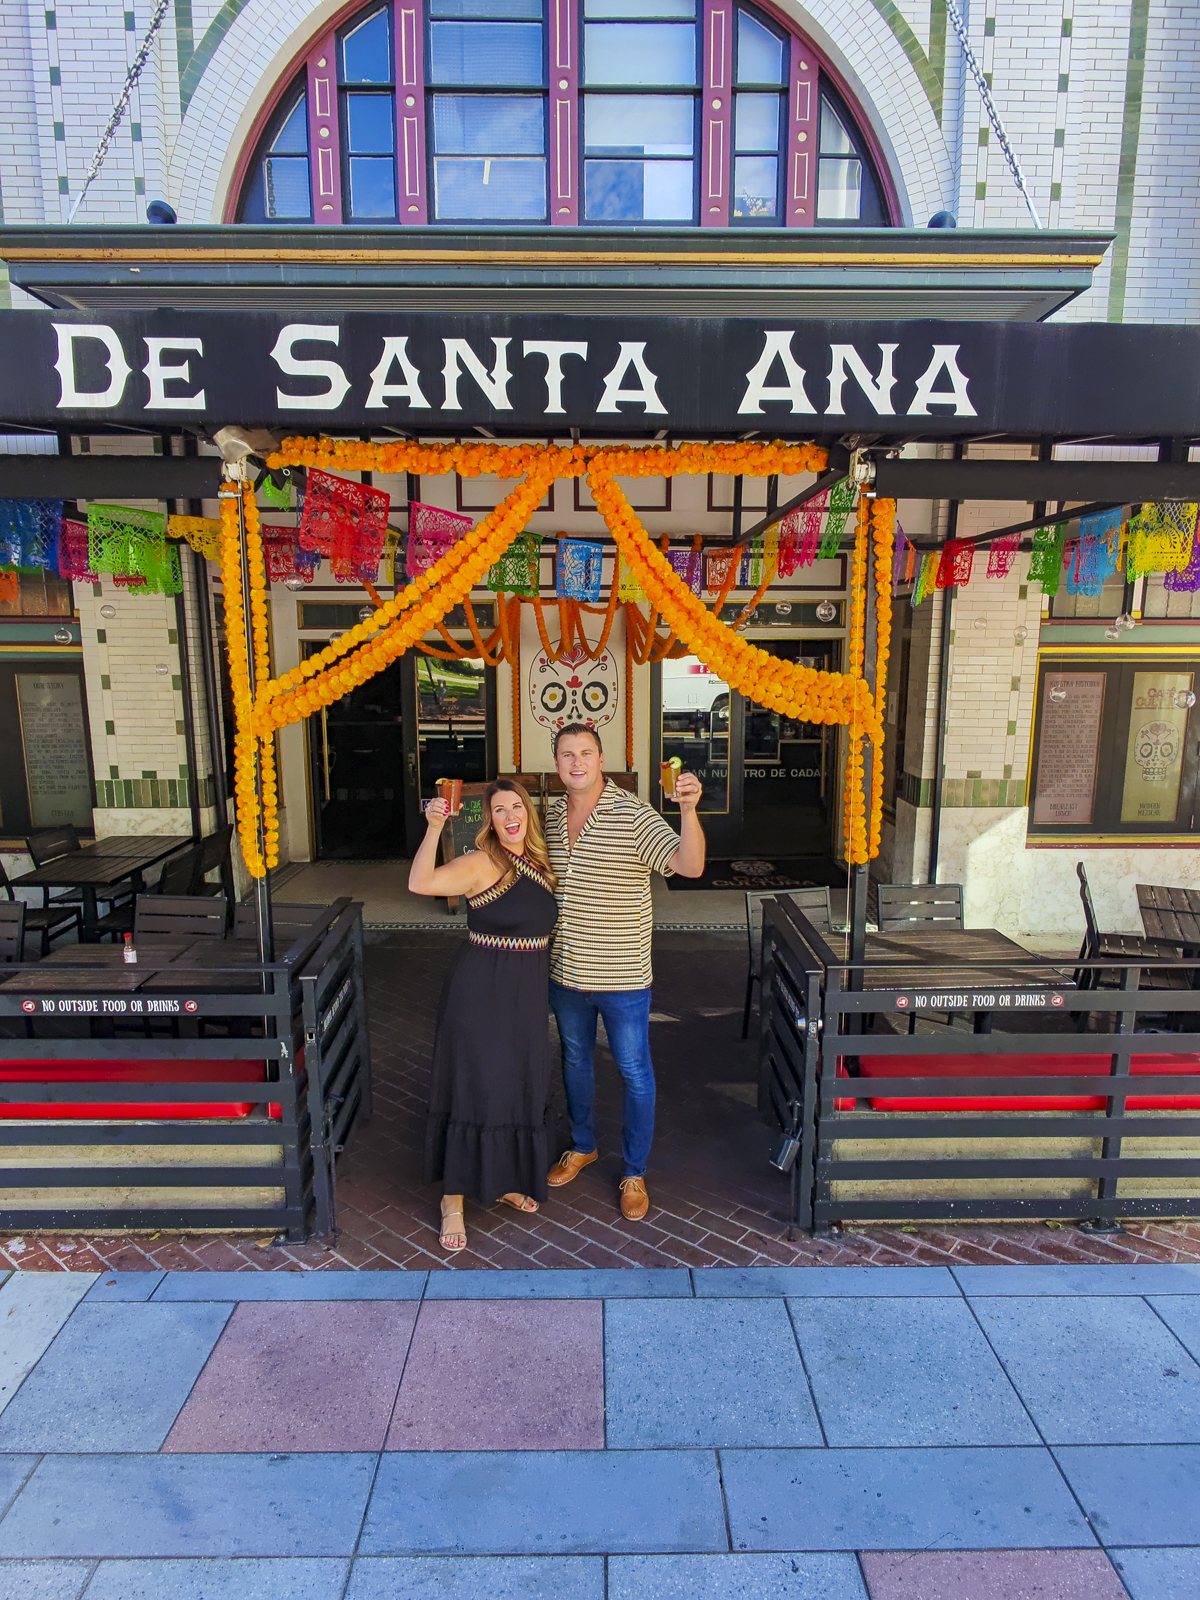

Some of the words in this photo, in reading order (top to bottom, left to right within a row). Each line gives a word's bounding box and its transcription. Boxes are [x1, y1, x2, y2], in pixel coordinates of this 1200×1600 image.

[51, 322, 207, 411] DE
[269, 323, 669, 414] SANTA
[737, 329, 978, 417] ANA
[770, 768, 786, 778] DE
[790, 768, 821, 778] CADA
[42, 1000, 55, 1012] NO
[58, 1000, 99, 1012] OUTSIDE
[102, 1000, 127, 1012] FOOD
[130, 1000, 144, 1012] OR
[147, 1000, 180, 1012] DRINKS
[915, 995, 927, 1008] NO
[930, 995, 969, 1007] OUTSIDE
[972, 995, 996, 1007] FOOD
[999, 994, 1011, 1006] OR
[1014, 994, 1046, 1006] DRINKS
